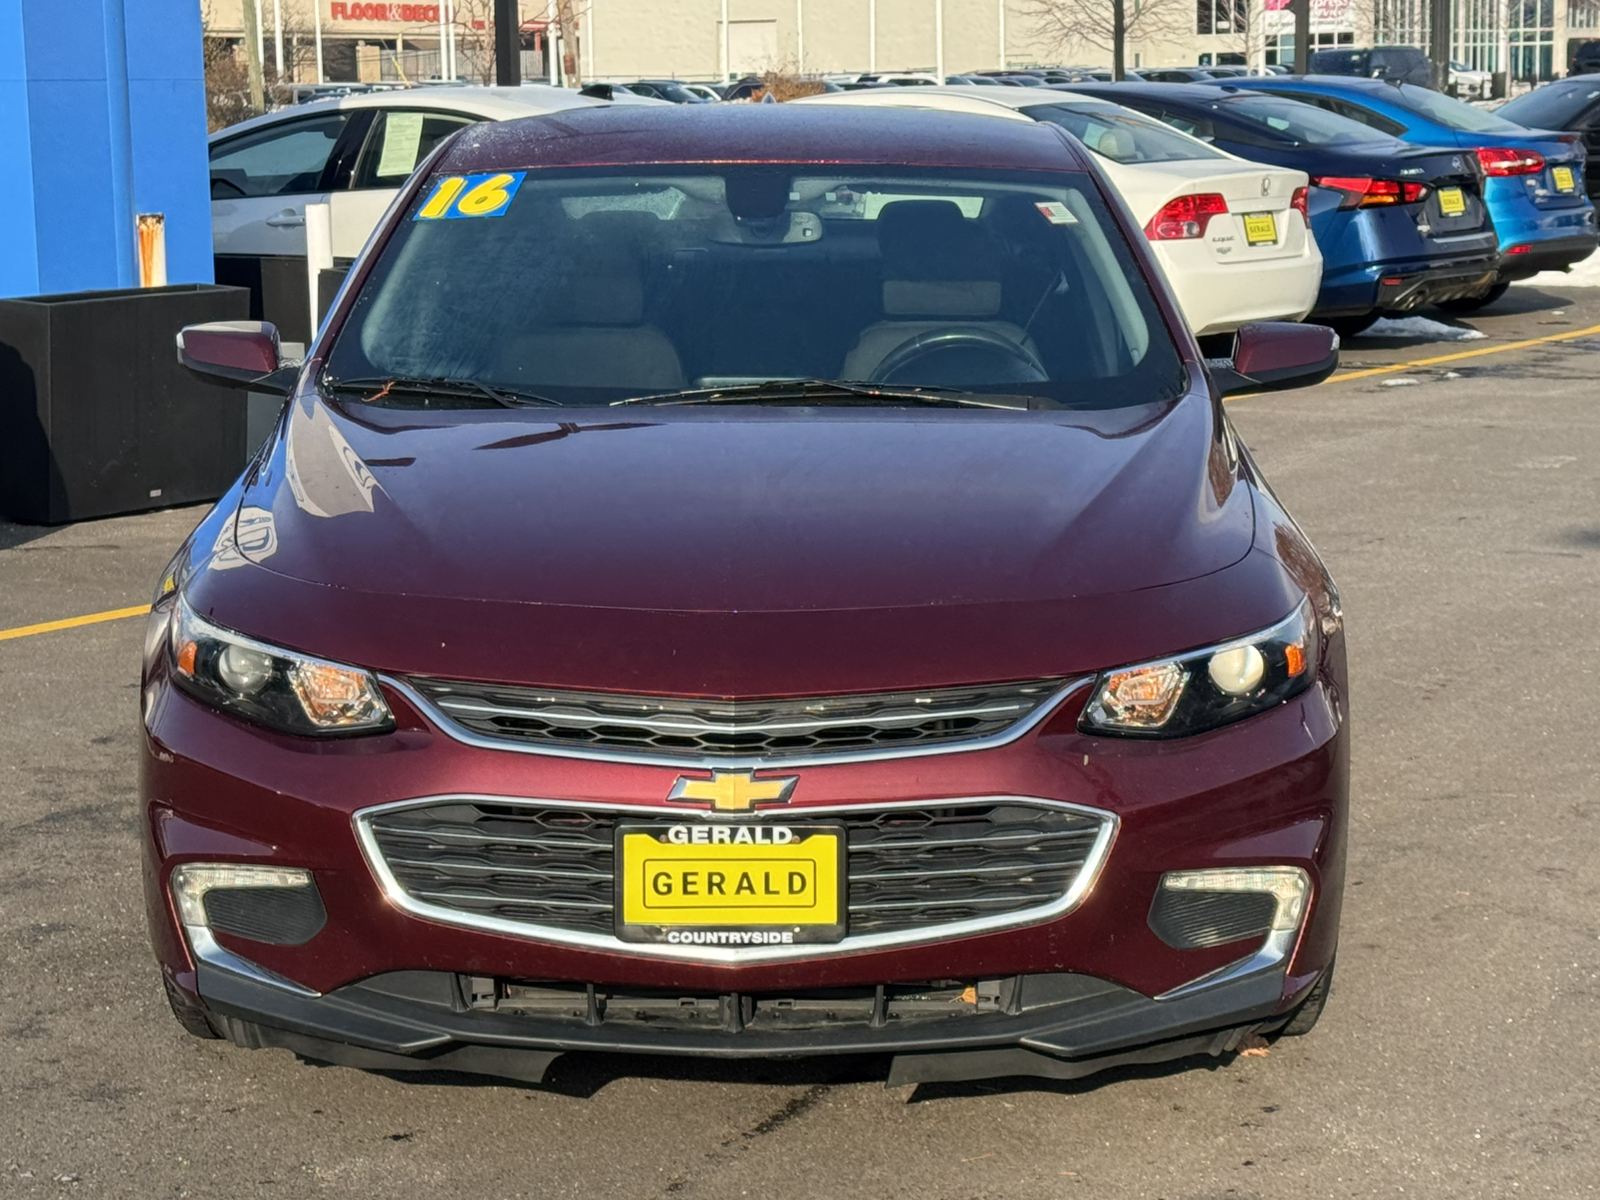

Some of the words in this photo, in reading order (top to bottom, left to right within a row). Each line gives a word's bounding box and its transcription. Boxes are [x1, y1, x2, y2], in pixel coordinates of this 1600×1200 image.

[419, 174, 515, 218] 16
[667, 825, 793, 845] GERALD
[652, 871, 807, 896] GERALD
[667, 931, 793, 944] COUNTRYSIDE
